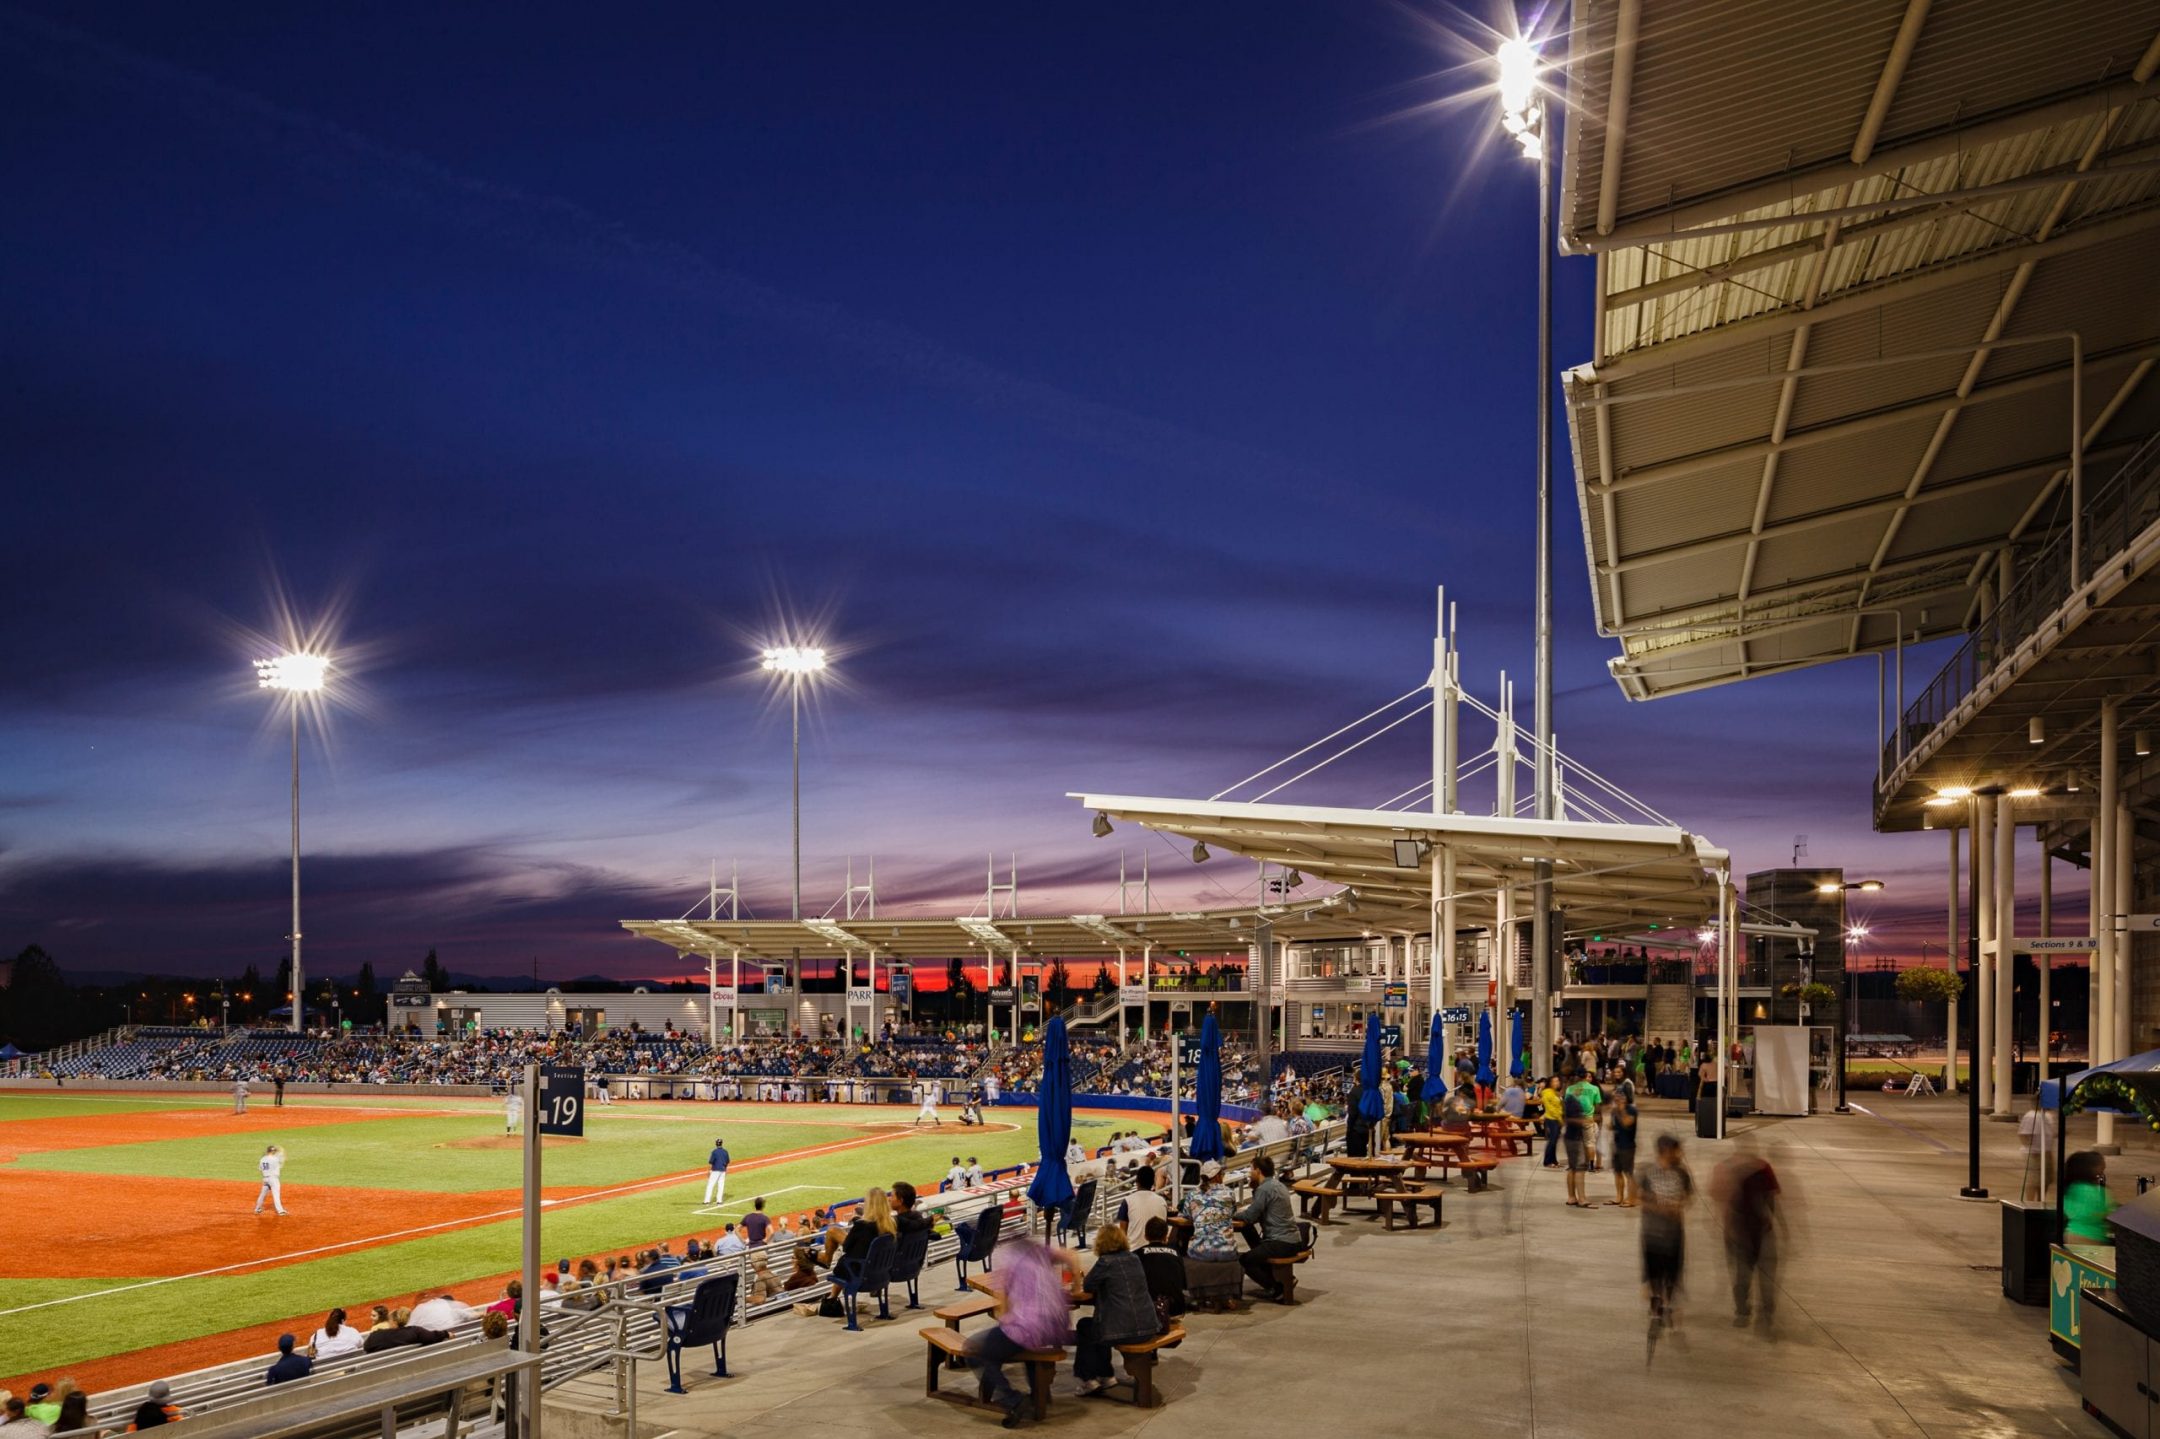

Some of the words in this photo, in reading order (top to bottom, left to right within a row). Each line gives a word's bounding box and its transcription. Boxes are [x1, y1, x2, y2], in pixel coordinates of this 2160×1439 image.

[2030, 940, 2065, 949] Sections
[2068, 940, 2074, 948] 9
[2087, 940, 2097, 948] 10
[847, 990, 872, 1000] PARR
[1386, 1034, 1399, 1045] 17
[1187, 1048, 1202, 1064] 18
[552, 1095, 578, 1126] 19
